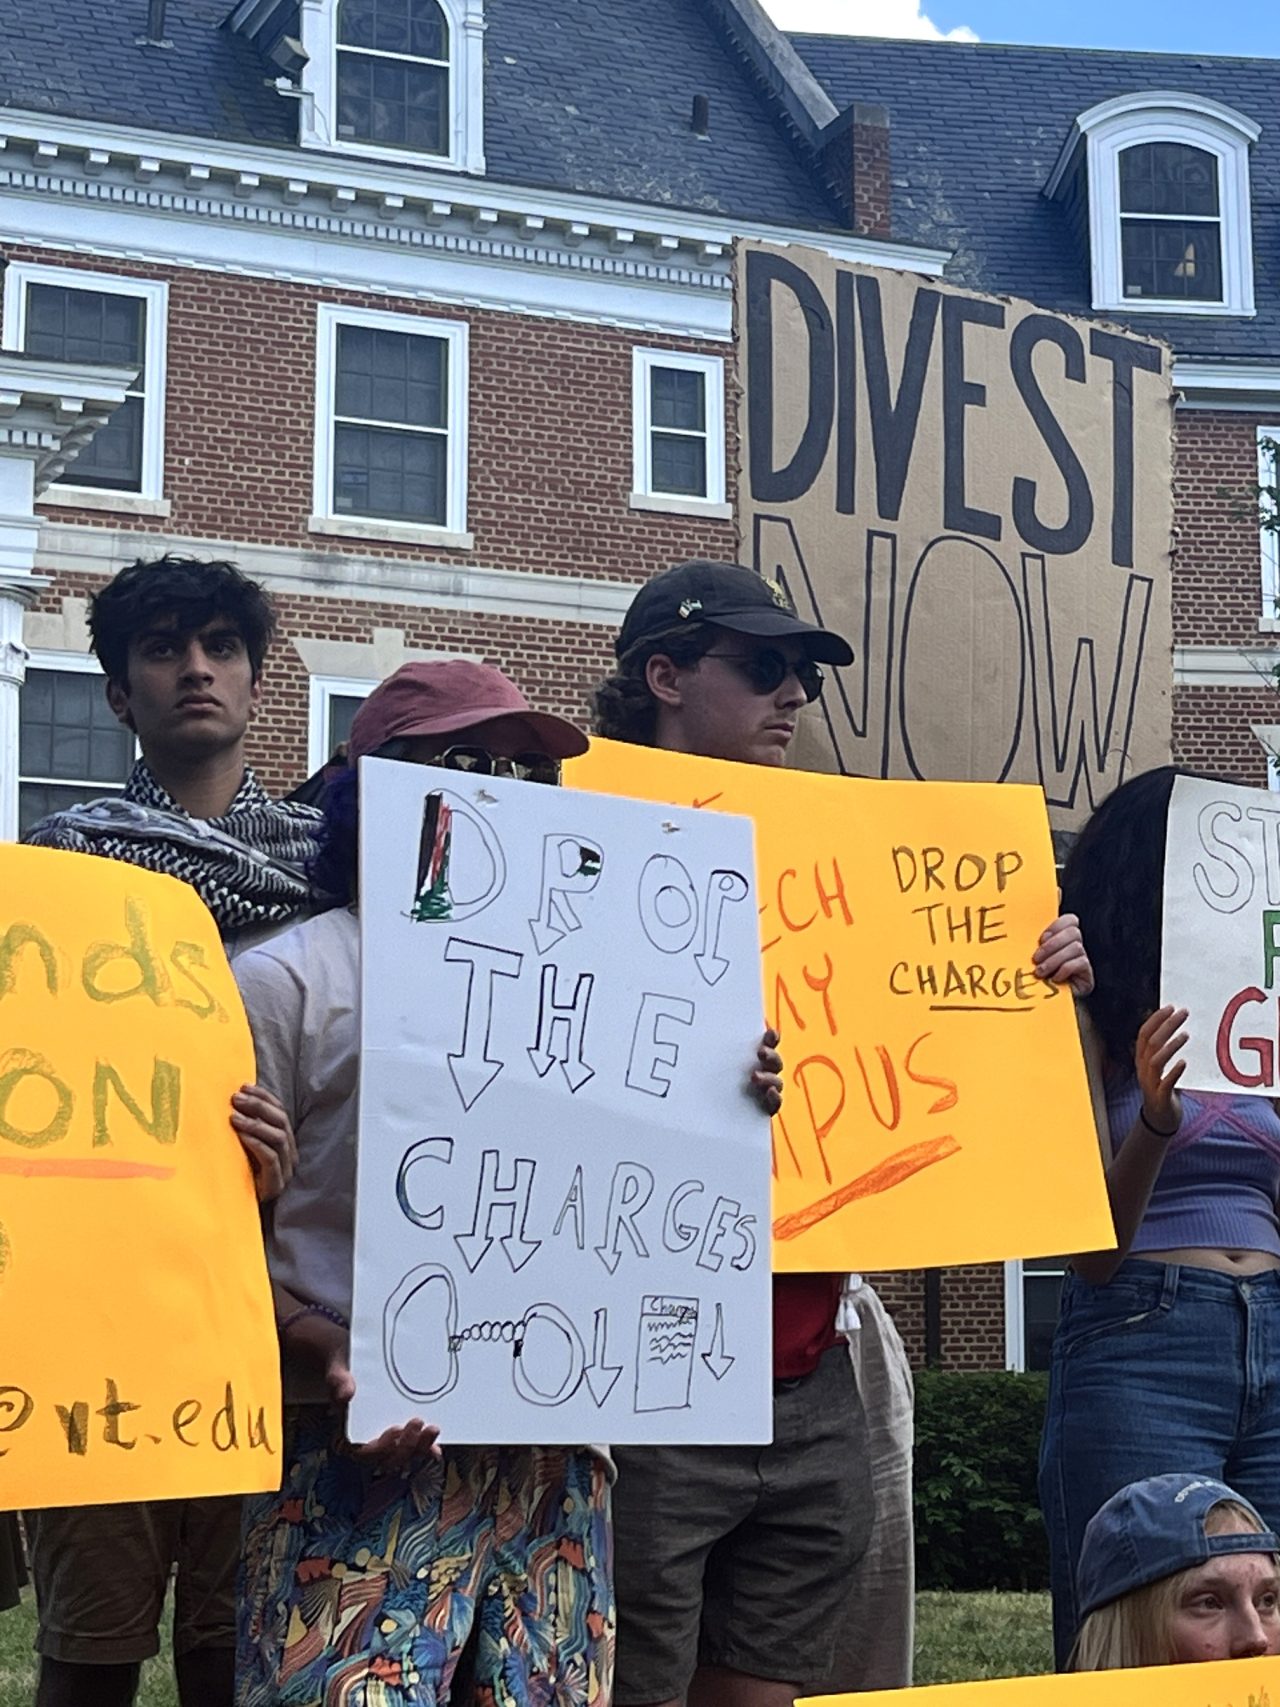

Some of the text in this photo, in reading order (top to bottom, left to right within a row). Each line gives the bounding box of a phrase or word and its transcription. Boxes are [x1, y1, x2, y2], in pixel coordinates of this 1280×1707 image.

[745, 250, 1161, 568] DIVEST
[753, 513, 1154, 808] NOW
[400, 787, 749, 986] DROP
[891, 845, 1023, 894] DROP
[912, 902, 1008, 946] THE
[444, 936, 695, 1112] THE
[889, 960, 1060, 1001] CHARGES
[396, 1136, 757, 1275] CHARGES
